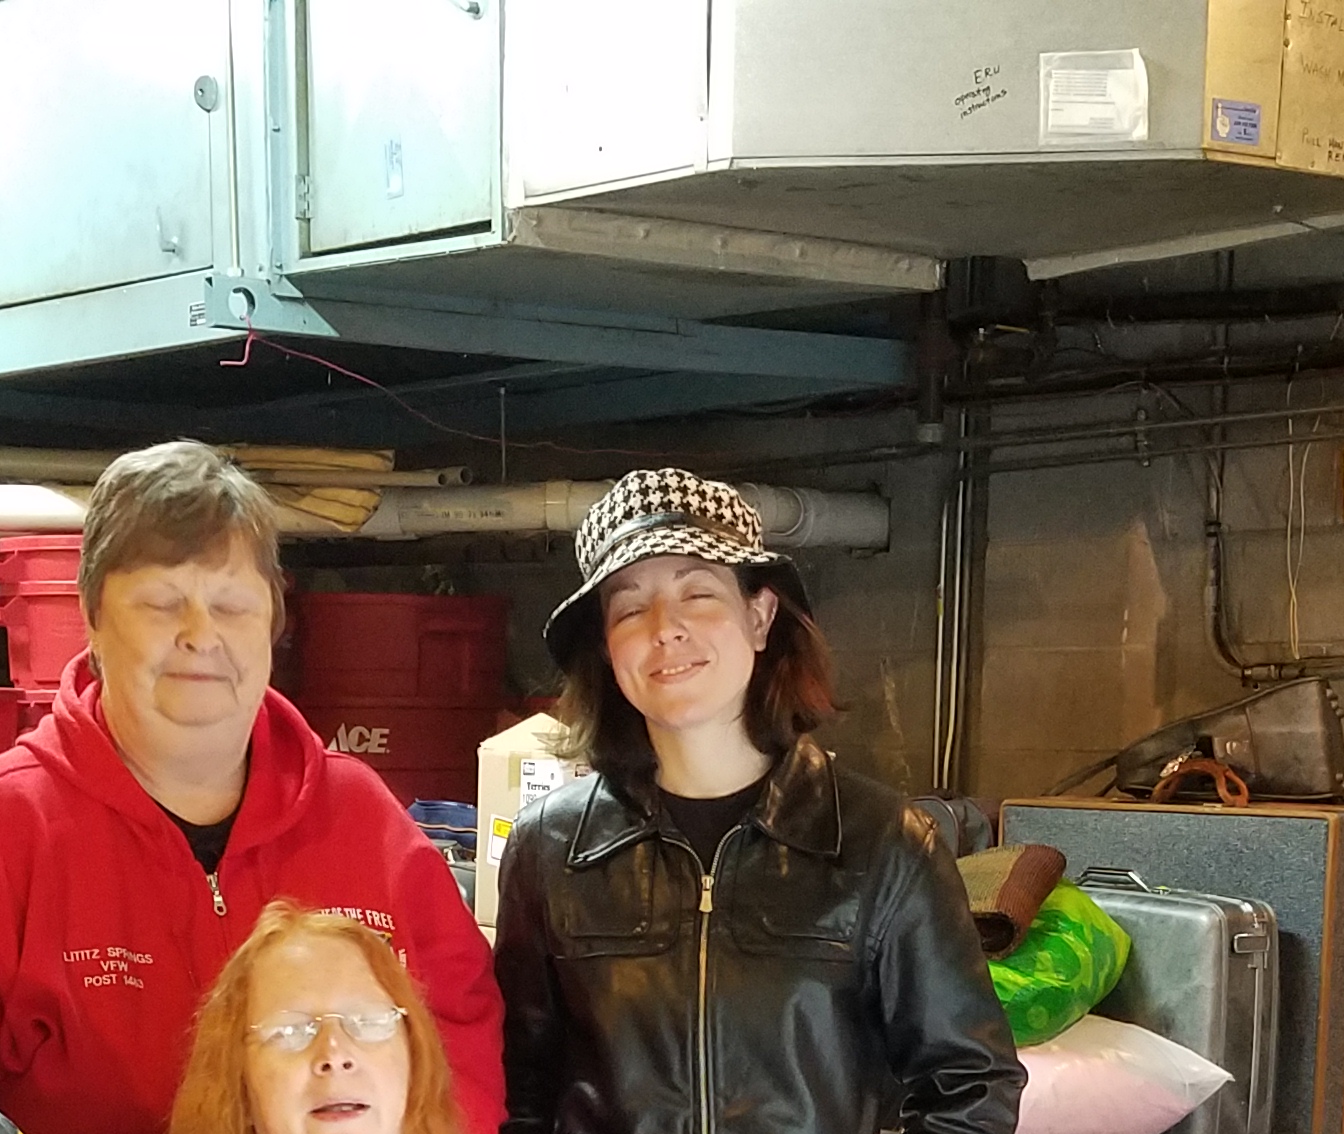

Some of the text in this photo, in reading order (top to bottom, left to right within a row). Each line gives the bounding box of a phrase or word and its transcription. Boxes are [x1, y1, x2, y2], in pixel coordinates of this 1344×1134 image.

[973, 64, 1001, 85] ERU
[327, 722, 390, 753] ACE
[365, 909, 396, 930] FREE
[63, 948, 101, 963] LITITZ
[99, 960, 128, 972] VFW
[84, 974, 117, 988] POST
